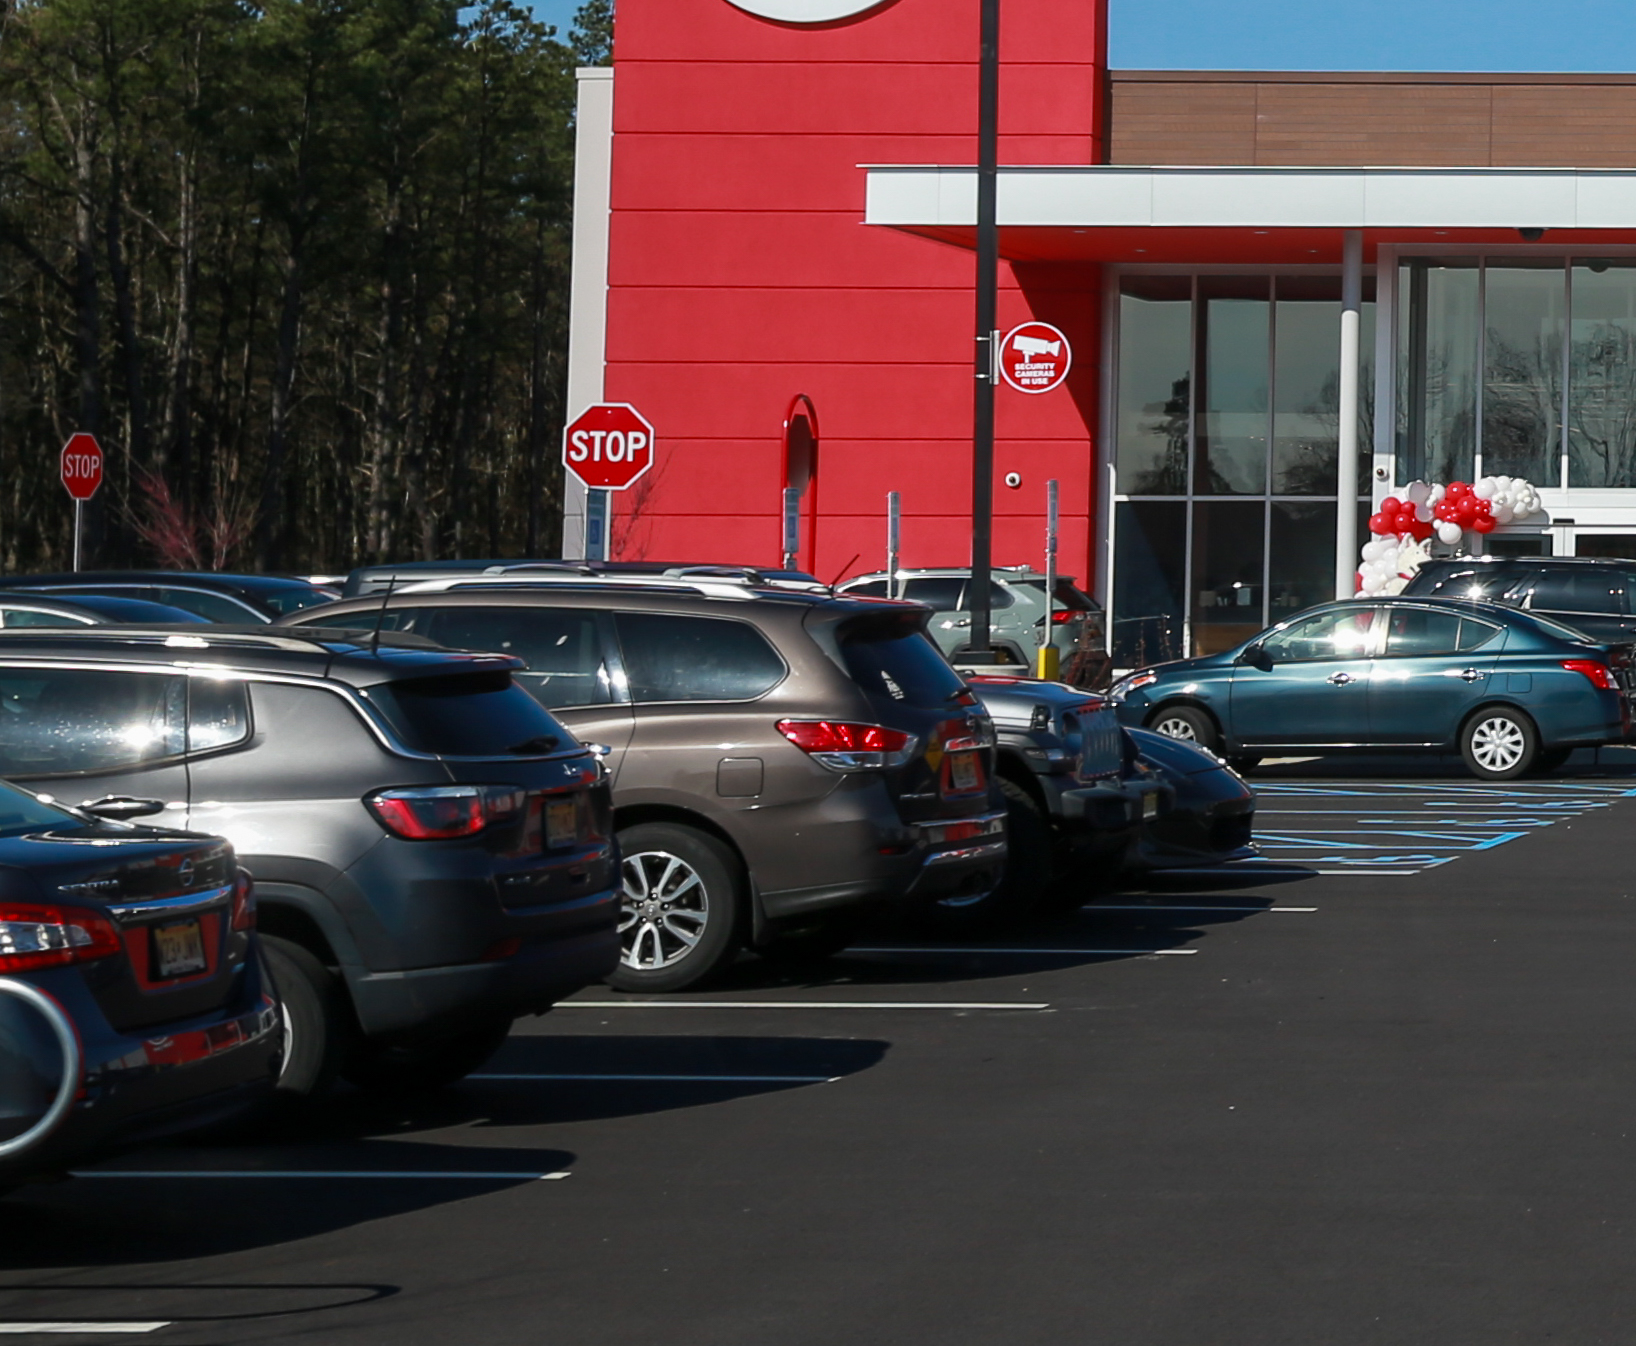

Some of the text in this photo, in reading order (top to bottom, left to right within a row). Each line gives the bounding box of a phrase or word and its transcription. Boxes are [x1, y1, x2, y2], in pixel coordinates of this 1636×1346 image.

[1014, 362, 1056, 370] SECURITY
[1014, 370, 1055, 378] CAMERAS
[1021, 377, 1048, 385] IN USE
[569, 429, 647, 462] STOP
[65, 454, 100, 479] STOP
